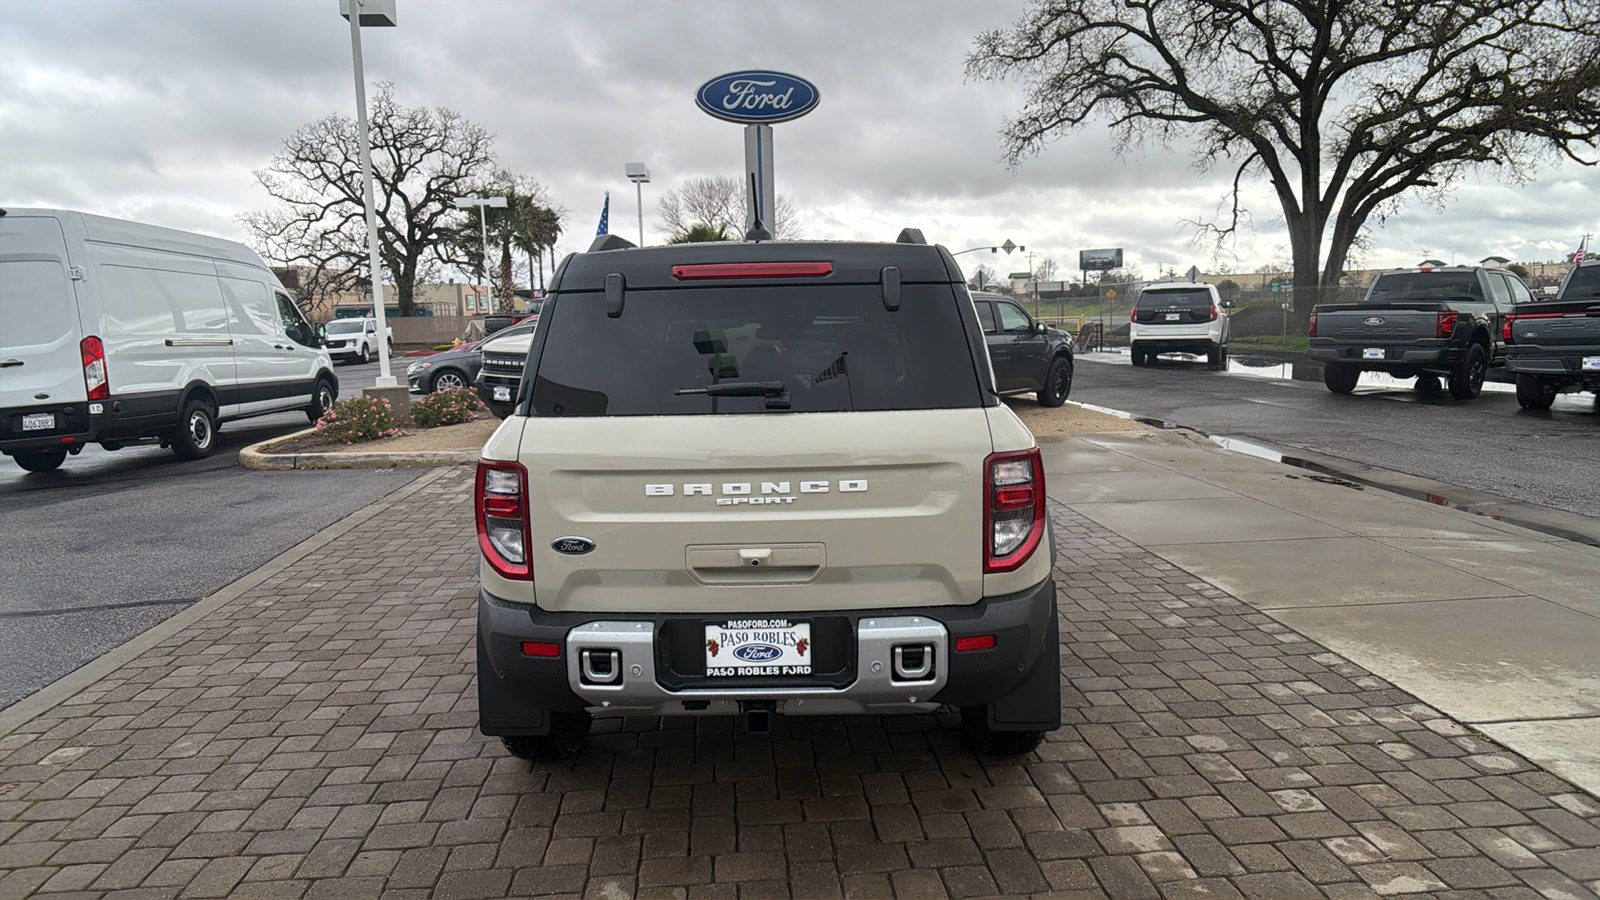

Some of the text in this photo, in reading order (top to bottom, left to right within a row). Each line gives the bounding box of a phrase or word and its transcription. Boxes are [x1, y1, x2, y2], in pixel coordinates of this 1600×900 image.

[722, 79, 795, 110] Ford
[645, 479, 869, 496] BRONCO
[716, 496, 797, 506] SPORT
[560, 540, 585, 551] Ford
[728, 620, 787, 628] PASOFORD.COM
[720, 632, 796, 648] PASO ROBLES
[743, 646, 773, 658] Ford
[706, 666, 811, 677] PASO ROBLES FORD
